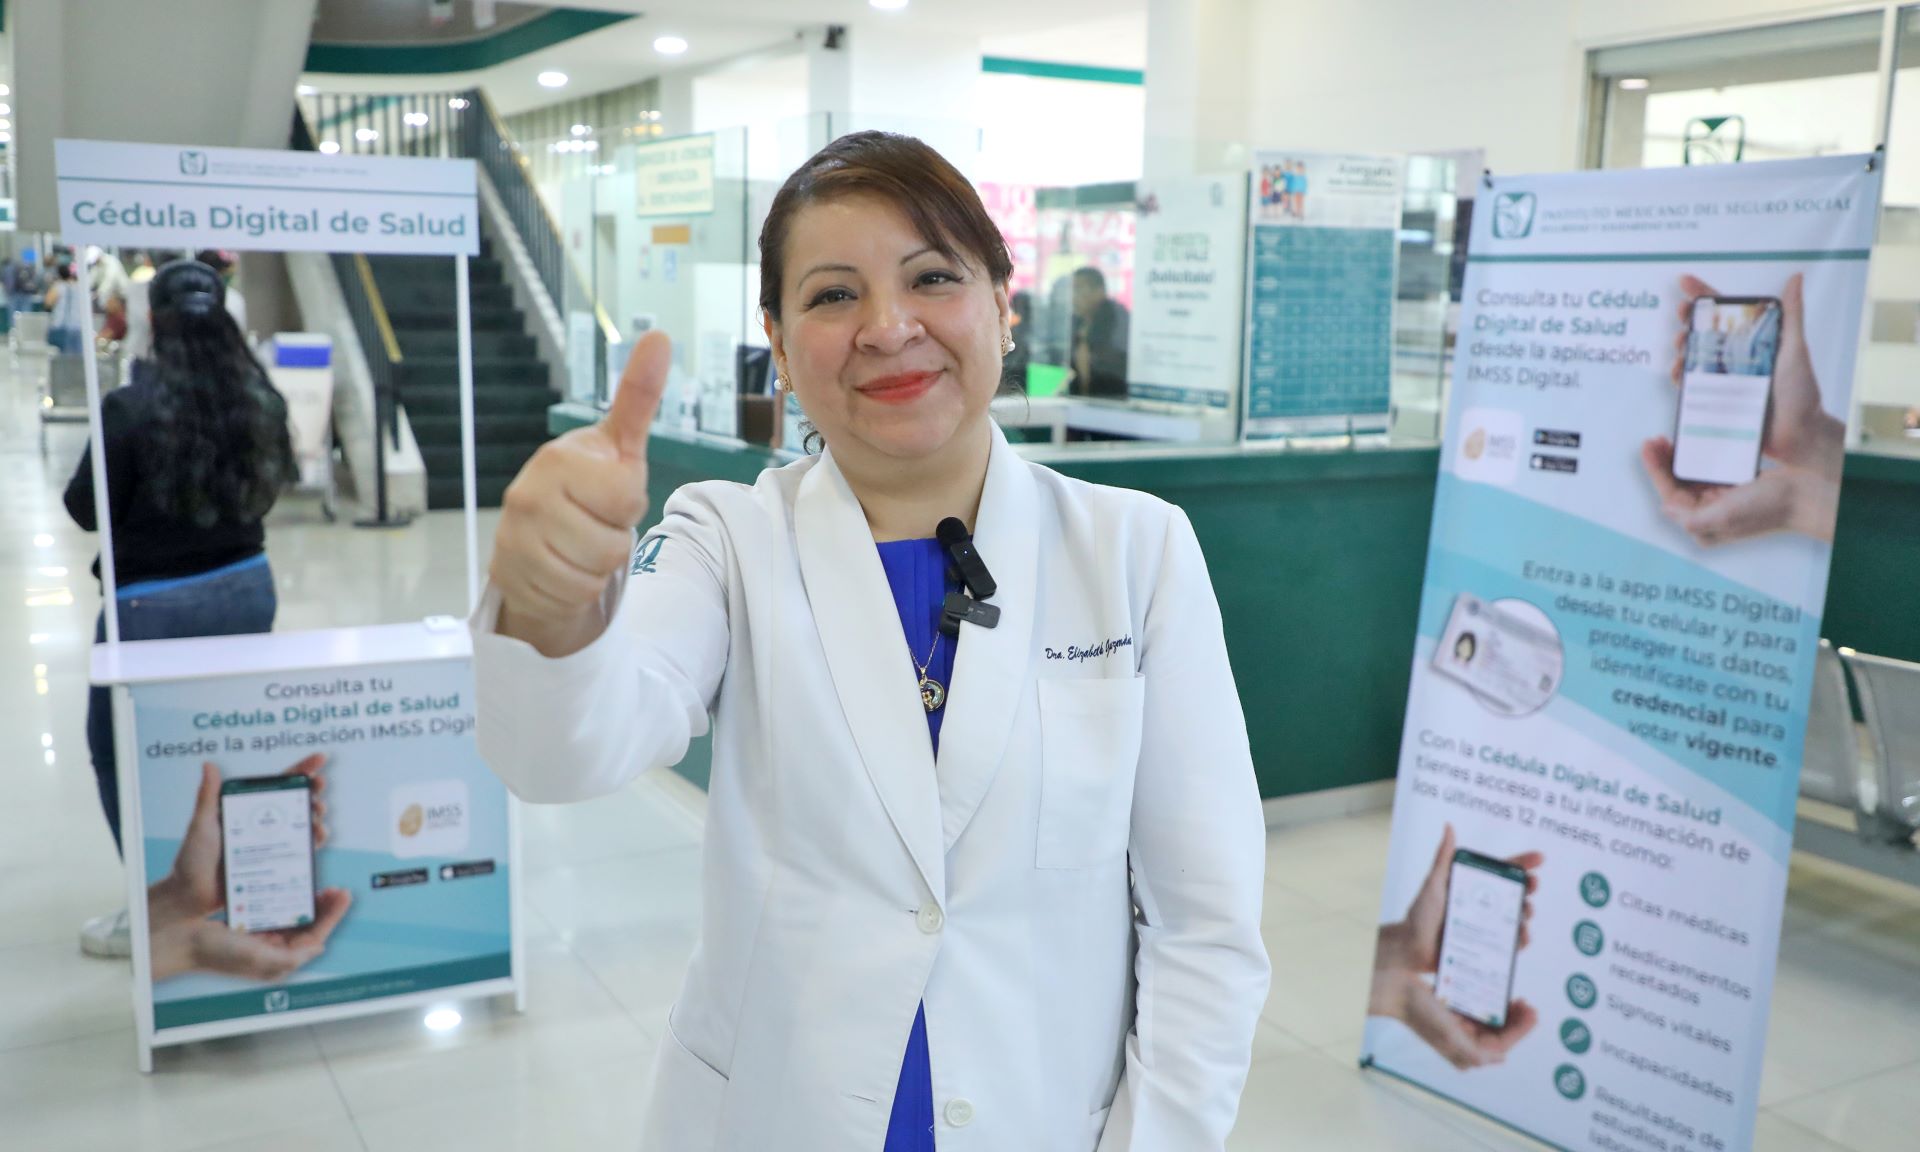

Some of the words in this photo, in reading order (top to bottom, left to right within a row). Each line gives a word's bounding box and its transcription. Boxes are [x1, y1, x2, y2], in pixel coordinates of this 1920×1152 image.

[73, 200, 196, 229] Cédula
[209, 206, 319, 236] Digital
[331, 210, 369, 233] de
[379, 212, 466, 236] Salud
[1615, 203, 1688, 219] MEXICANO
[1693, 203, 1720, 216] DEL
[1725, 199, 1789, 216] SEGURO
[1793, 196, 1852, 212] SOCIAL
[1477, 289, 1556, 307] Consulta
[1562, 291, 1582, 307] tu
[1588, 290, 1660, 309] Cédula
[1474, 314, 1535, 336] Digital
[1540, 317, 1564, 333] de
[1570, 317, 1627, 336] Salud
[1469, 342, 1524, 358] desde
[1530, 342, 1544, 358] la
[1551, 344, 1650, 363] aplicación
[1467, 366, 1512, 384] IMSS
[1517, 367, 1580, 390] Digital.
[1522, 560, 1575, 585] Entra
[1580, 573, 1592, 588] a
[1597, 572, 1615, 592] la
[1619, 580, 1661, 601] app
[1665, 584, 1716, 610] IMSS
[1722, 592, 1802, 623] Digital
[1554, 595, 1616, 620] desde
[1621, 606, 1644, 625] tu
[1648, 612, 1716, 638] celular
[1722, 626, 1737, 646] y
[1743, 630, 1797, 654] para
[1045, 647, 1065, 660] Dra.
[1067, 641, 1104, 663] Elizabeth
[1588, 628, 1676, 659] proteger
[1683, 647, 1715, 667] tus
[264, 678, 365, 700] Consulta
[370, 677, 393, 694] tu
[1713, 682, 1758, 704] con
[1766, 689, 1789, 712] tu
[193, 707, 276, 730] Cédula
[284, 700, 359, 727] Digital
[366, 698, 393, 716] de
[399, 692, 461, 713] Salud
[1611, 685, 1727, 727] credencial
[1732, 714, 1785, 741] para
[1627, 717, 1678, 744] votar
[146, 736, 218, 760] desde
[225, 735, 244, 752] la
[251, 724, 365, 752] aplicación
[370, 718, 423, 740] IMSS
[1418, 729, 1456, 751] Con
[1459, 738, 1474, 757] la
[1478, 744, 1547, 776] Cédula
[1553, 763, 1620, 797] Digital
[1624, 784, 1649, 806] de
[1655, 792, 1721, 826] Salud
[427, 803, 463, 821] IMSS
[1412, 775, 1439, 798] los
[1442, 784, 1513, 821] últimos
[1517, 805, 1536, 827] 12
[1416, 753, 1470, 782] tienes
[1474, 771, 1541, 801] acceso
[1545, 791, 1556, 806] a
[1560, 795, 1581, 814] tu
[1586, 800, 1715, 853] información
[1719, 840, 1751, 863] de
[1618, 890, 1664, 918] Citas
[1667, 908, 1750, 947] médicas
[1609, 963, 1701, 1006] recetados
[1612, 939, 1753, 1001] Medicamentos
[1605, 992, 1667, 1029] Signos
[1670, 1020, 1733, 1055] vitales
[1600, 1038, 1736, 1106] Incapacidades
[1592, 1110, 1667, 1151] estudios
[1595, 1085, 1695, 1140] Resultados
[1699, 1132, 1726, 1151] de
